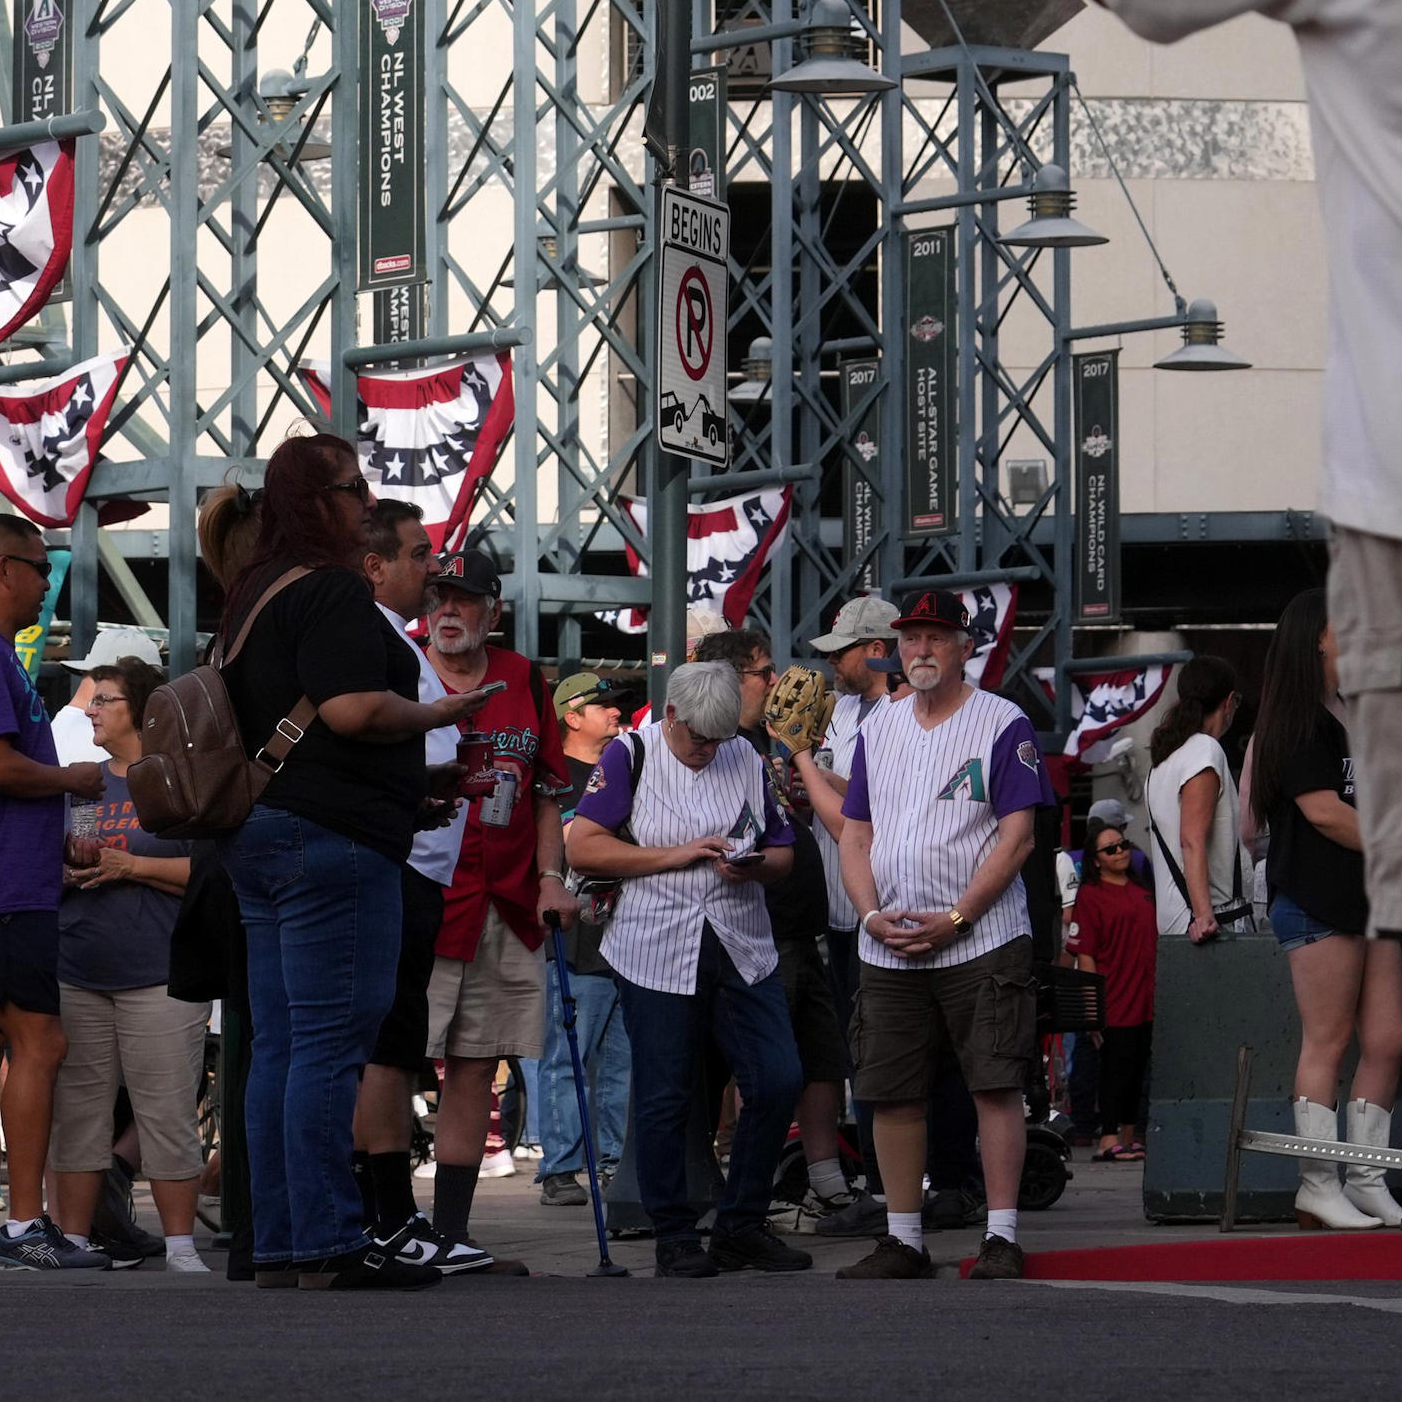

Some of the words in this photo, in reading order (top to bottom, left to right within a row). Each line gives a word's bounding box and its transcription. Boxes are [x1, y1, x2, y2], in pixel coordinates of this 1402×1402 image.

[394, 52, 404, 87] NL
[44, 75, 54, 109] NL
[689, 83, 715, 102] 002
[380, 54, 392, 208] CHAMPIONS
[394, 91, 404, 163] WEST
[671, 202, 721, 255] BEGINS
[913, 240, 941, 257] 2011
[850, 370, 875, 385] 2017
[1083, 363, 1109, 378] 2017
[917, 368, 926, 418] HOST
[928, 367, 937, 453] ALL-STAR
[918, 421, 926, 461] SITE
[929, 456, 938, 510] GAME
[1097, 475, 1105, 496] NL
[1088, 475, 1097, 573] CHAMPIONS
[1097, 502, 1105, 541] WILD
[1097, 545, 1105, 591] CARD
